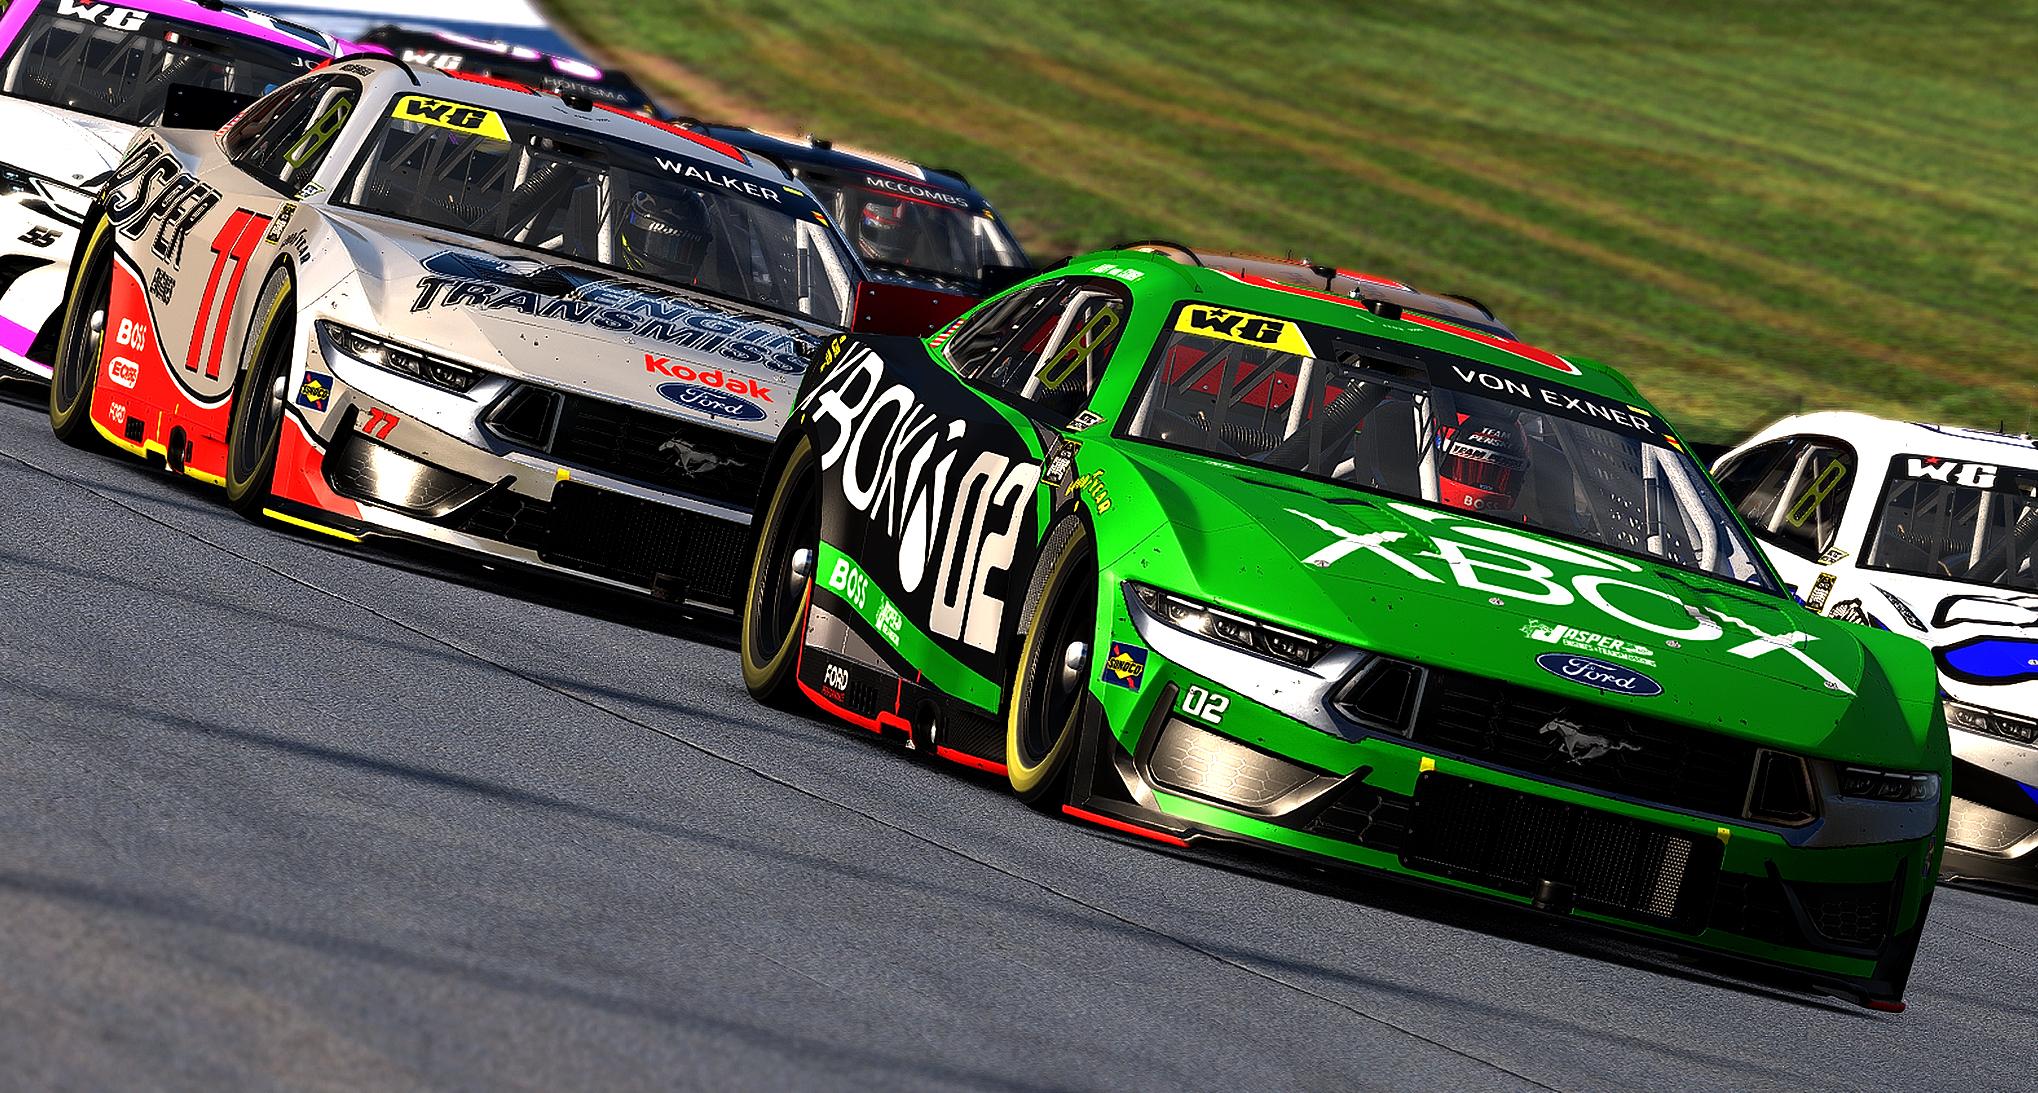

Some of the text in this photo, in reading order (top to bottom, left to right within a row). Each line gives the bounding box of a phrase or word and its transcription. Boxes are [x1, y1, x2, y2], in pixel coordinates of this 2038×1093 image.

[57, 0, 149, 31] WG
[402, 49, 463, 70] WG
[406, 100, 488, 128] WG
[654, 156, 782, 204] WALKER
[866, 176, 969, 208] MCCOMBS
[17, 225, 64, 248] 55
[115, 317, 148, 352] BOSS
[1191, 309, 1285, 343] WG
[643, 353, 775, 403] Kodak
[680, 385, 744, 416] Ford
[1451, 365, 1655, 435] VON EXNER
[361, 406, 401, 441] 77
[1907, 458, 1998, 489] WG
[929, 451, 1042, 655] 02
[829, 557, 869, 610] BOSS
[1283, 507, 1858, 698] XBOX
[824, 663, 849, 691] FORD
[1107, 657, 1144, 675] SUNOCO
[1561, 657, 1637, 689] Ford
[1181, 684, 1231, 725] 02
